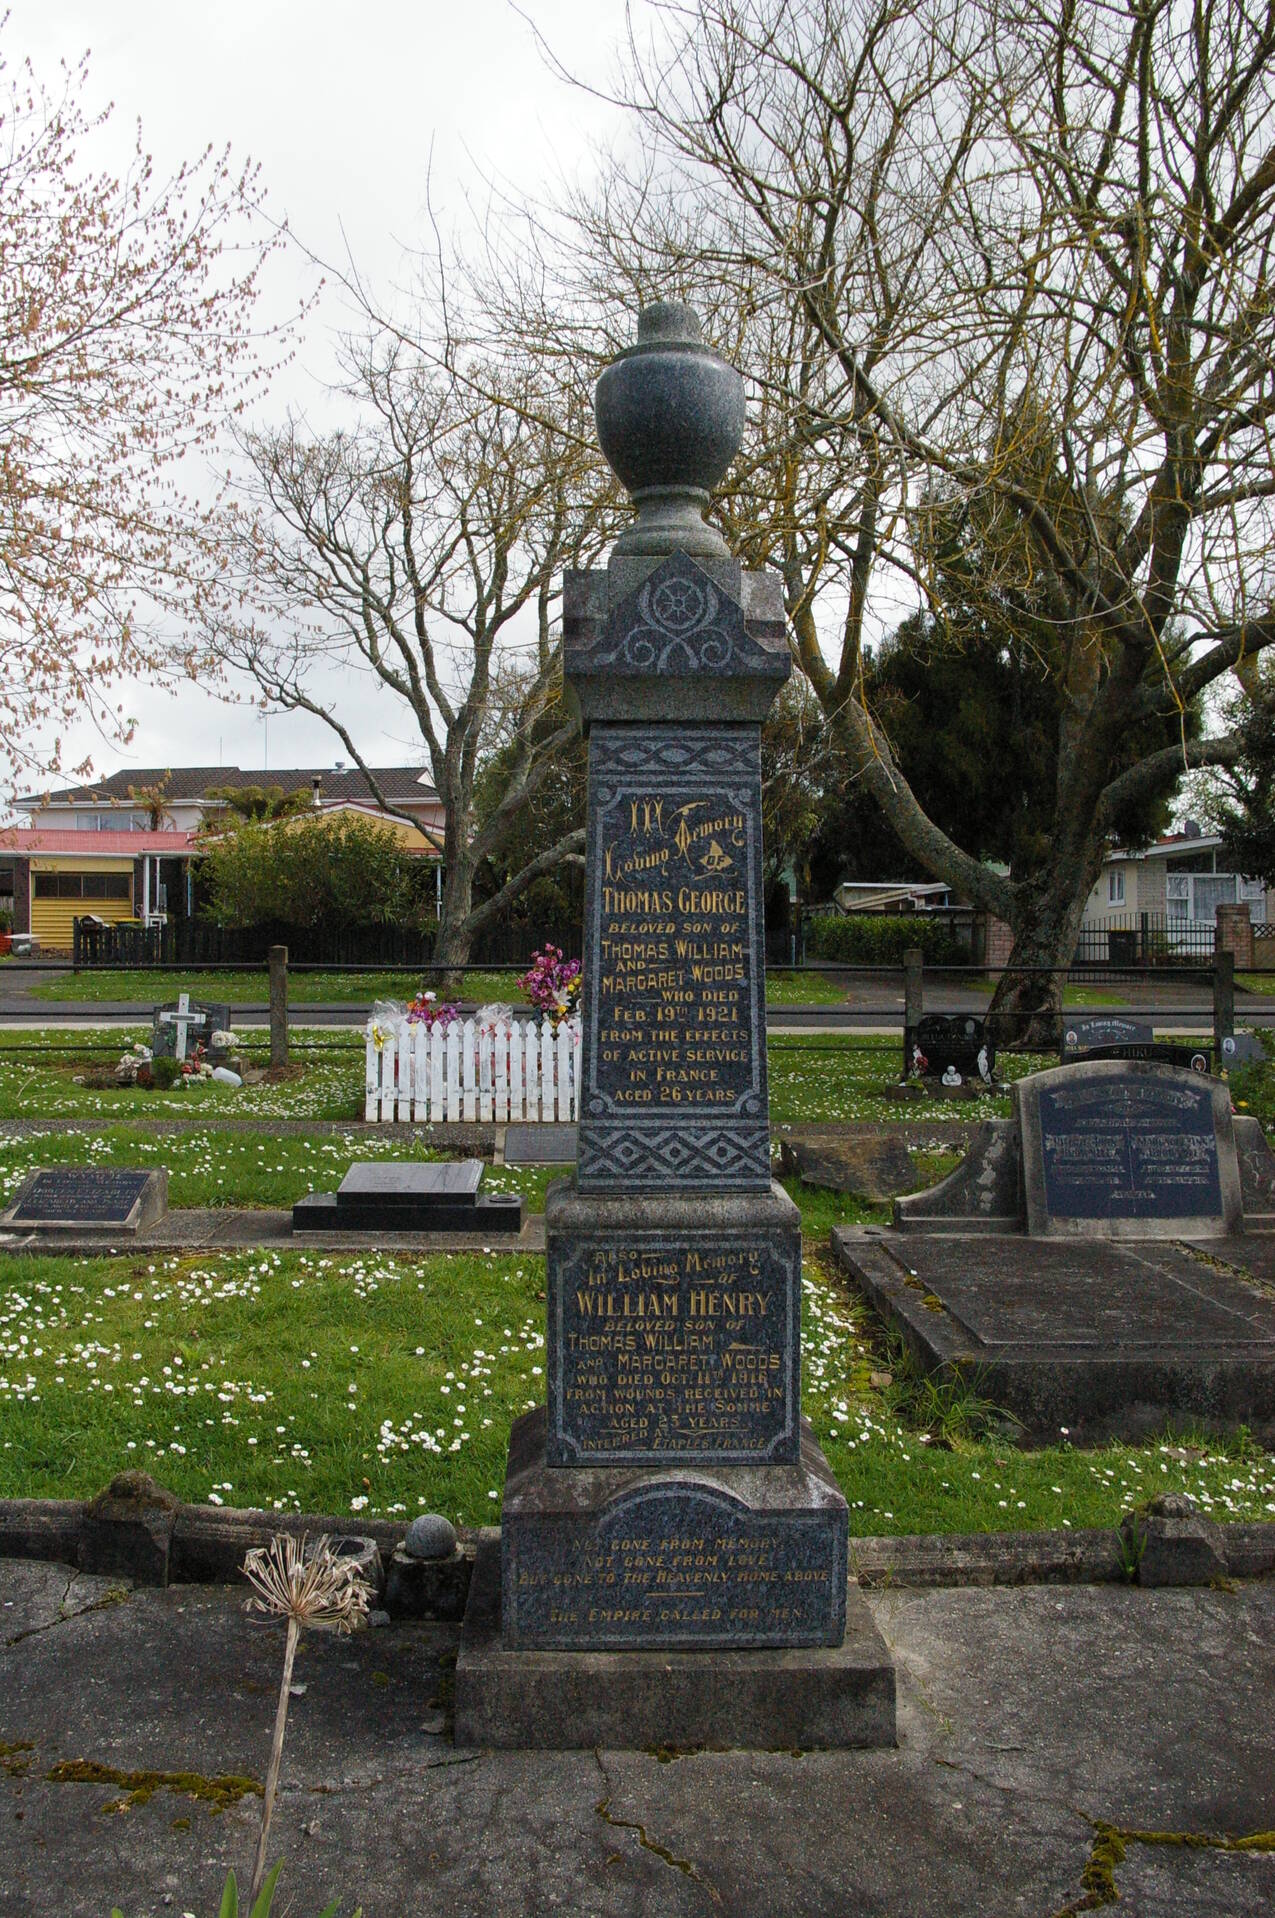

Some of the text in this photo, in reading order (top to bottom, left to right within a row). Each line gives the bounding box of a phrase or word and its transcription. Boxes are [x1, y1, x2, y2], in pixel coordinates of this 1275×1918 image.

[602, 887, 746, 914] THOMAS GEORGE
[608, 922, 741, 934] BELOVED SON OF
[602, 939, 743, 960] THOMAS WILLIAM
[615, 960, 646, 973] AND
[602, 963, 745, 994] MARGARET WOODS
[662, 991, 739, 1002] WHO DIED
[698, 1007, 738, 1022] 1921
[601, 1030, 749, 1042] FROM THE EFFECTS
[603, 1051, 749, 1062] OF ACTIVE SERVICE
[630, 1067, 719, 1082] IN FRANCE
[614, 1086, 736, 1101] AGED 26 YEARS
[718, 1273, 738, 1284] OF
[577, 1289, 772, 1317] WILLIAM HENRY
[604, 1320, 746, 1332] BELOVED SON OF
[568, 1333, 714, 1351] THOMAS WILLIAM
[577, 1352, 781, 1371] AND MARGARET WOODS
[577, 1374, 608, 1385] WHO
[617, 1374, 654, 1385] DIED
[566, 1386, 783, 1400] FROM WOUNDS RECEIVED IN
[579, 1400, 771, 1414] ACTION AT THE SOMME
[609, 1416, 649, 1428] AGED
[611, 1539, 651, 1550] GONE
[660, 1538, 705, 1550] FROM
[624, 1556, 665, 1567] GONE
[672, 1554, 719, 1566] FROM
[623, 1573, 651, 1584] THE
[737, 1571, 780, 1582] HOME
[588, 1608, 650, 1622] EMPIRE
[660, 1608, 722, 1620] CALLED
[729, 1608, 760, 1620] FOR
